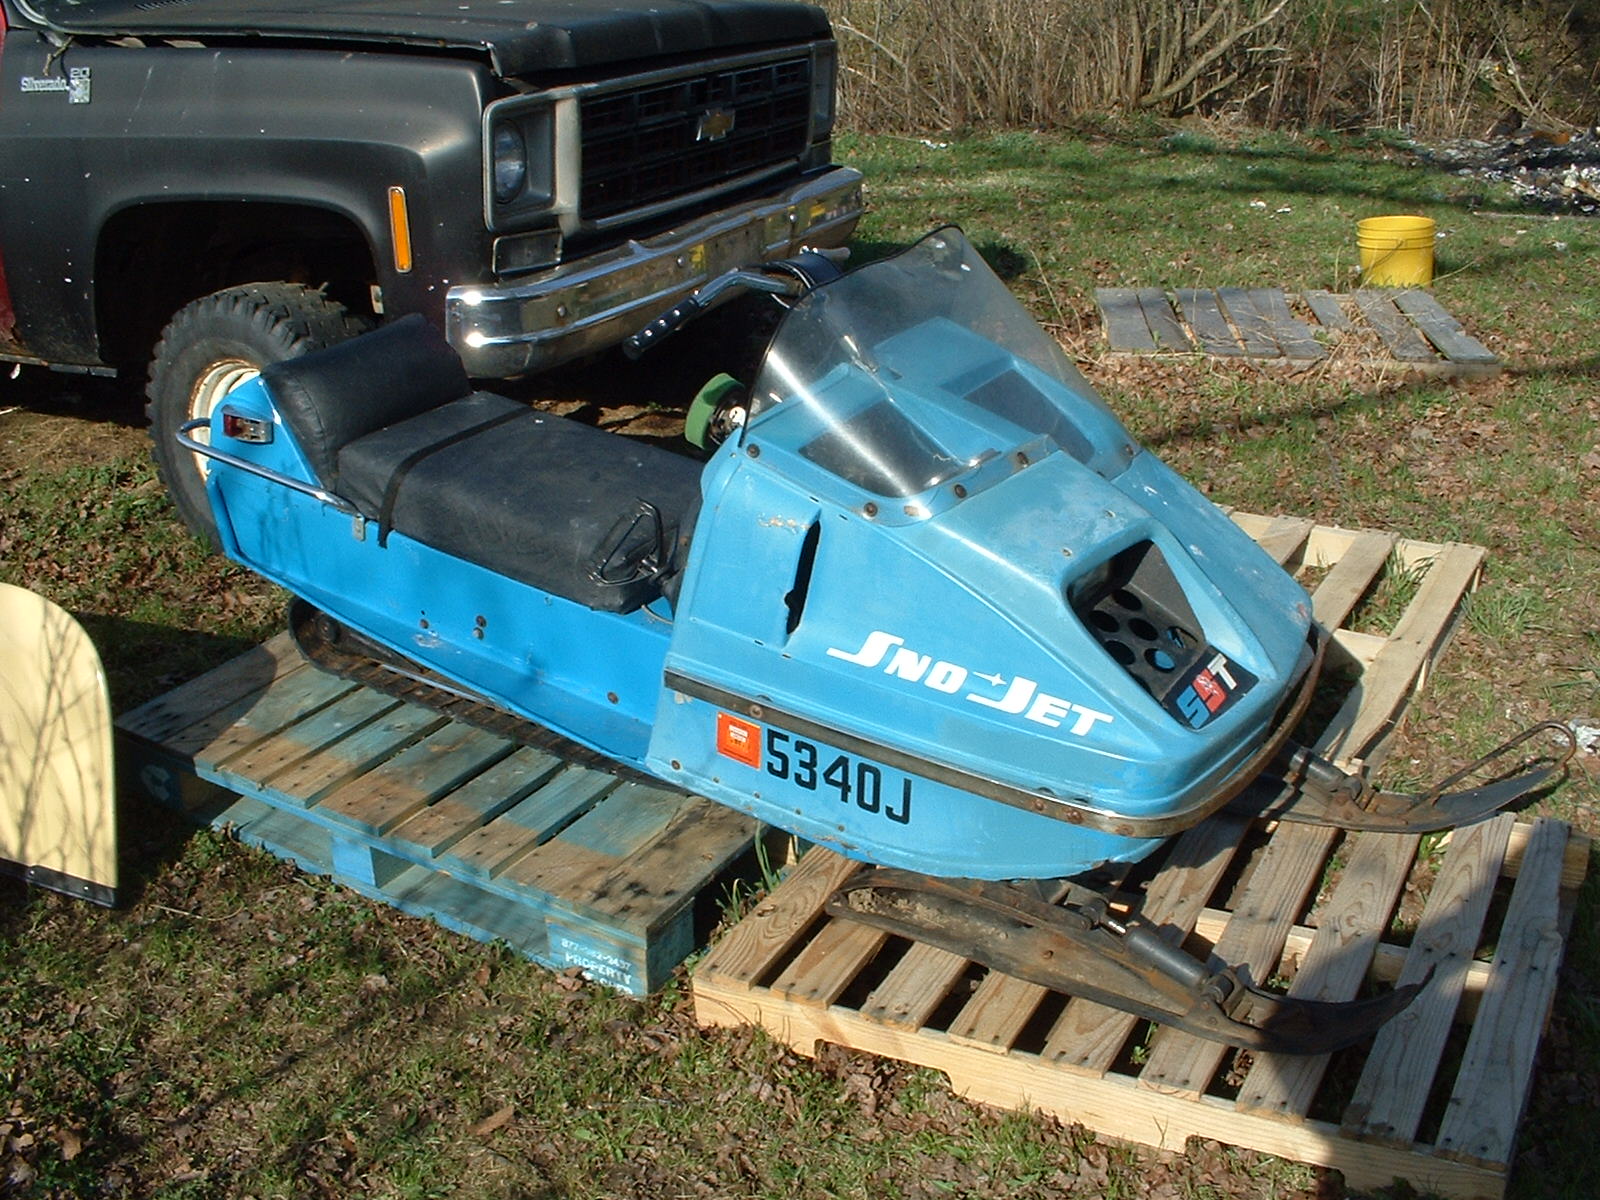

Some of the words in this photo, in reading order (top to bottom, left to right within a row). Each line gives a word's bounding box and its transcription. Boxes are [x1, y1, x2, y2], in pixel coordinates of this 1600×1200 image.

[70, 67, 90, 78] 20
[766, 728, 912, 825] 5340J
[565, 952, 632, 985] PROPERTY
